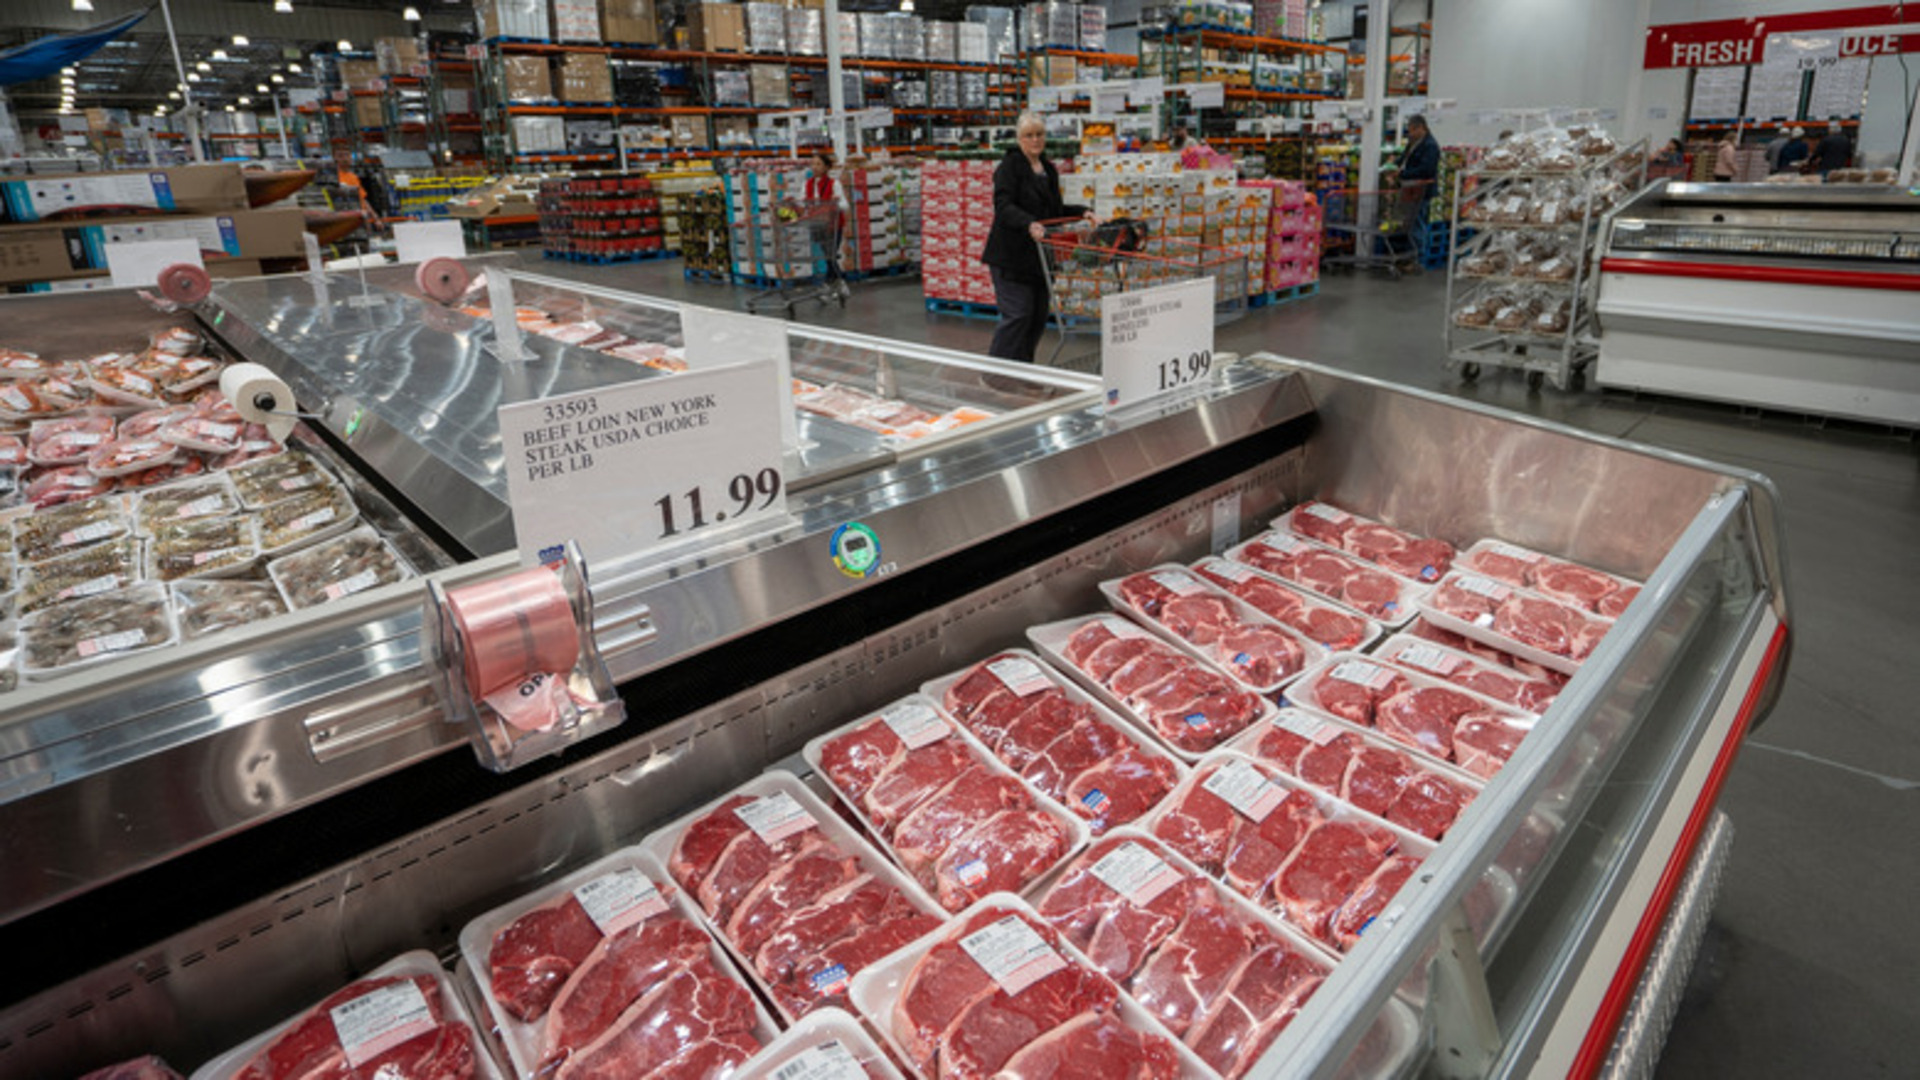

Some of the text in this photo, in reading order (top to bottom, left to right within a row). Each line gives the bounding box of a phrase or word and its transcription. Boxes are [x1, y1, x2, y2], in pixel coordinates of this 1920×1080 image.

[1672, 34, 1898, 65] FRESH UCE
[1159, 350, 1211, 390] 13.99
[523, 394, 717, 447] BEEF LOIN NEW YORK
[544, 397, 598, 423] 33593
[525, 412, 709, 464] STEAK USDA CHOICE
[528, 454, 594, 481] PER LB
[654, 467, 781, 540] 11.99
[519, 672, 551, 697] OP
